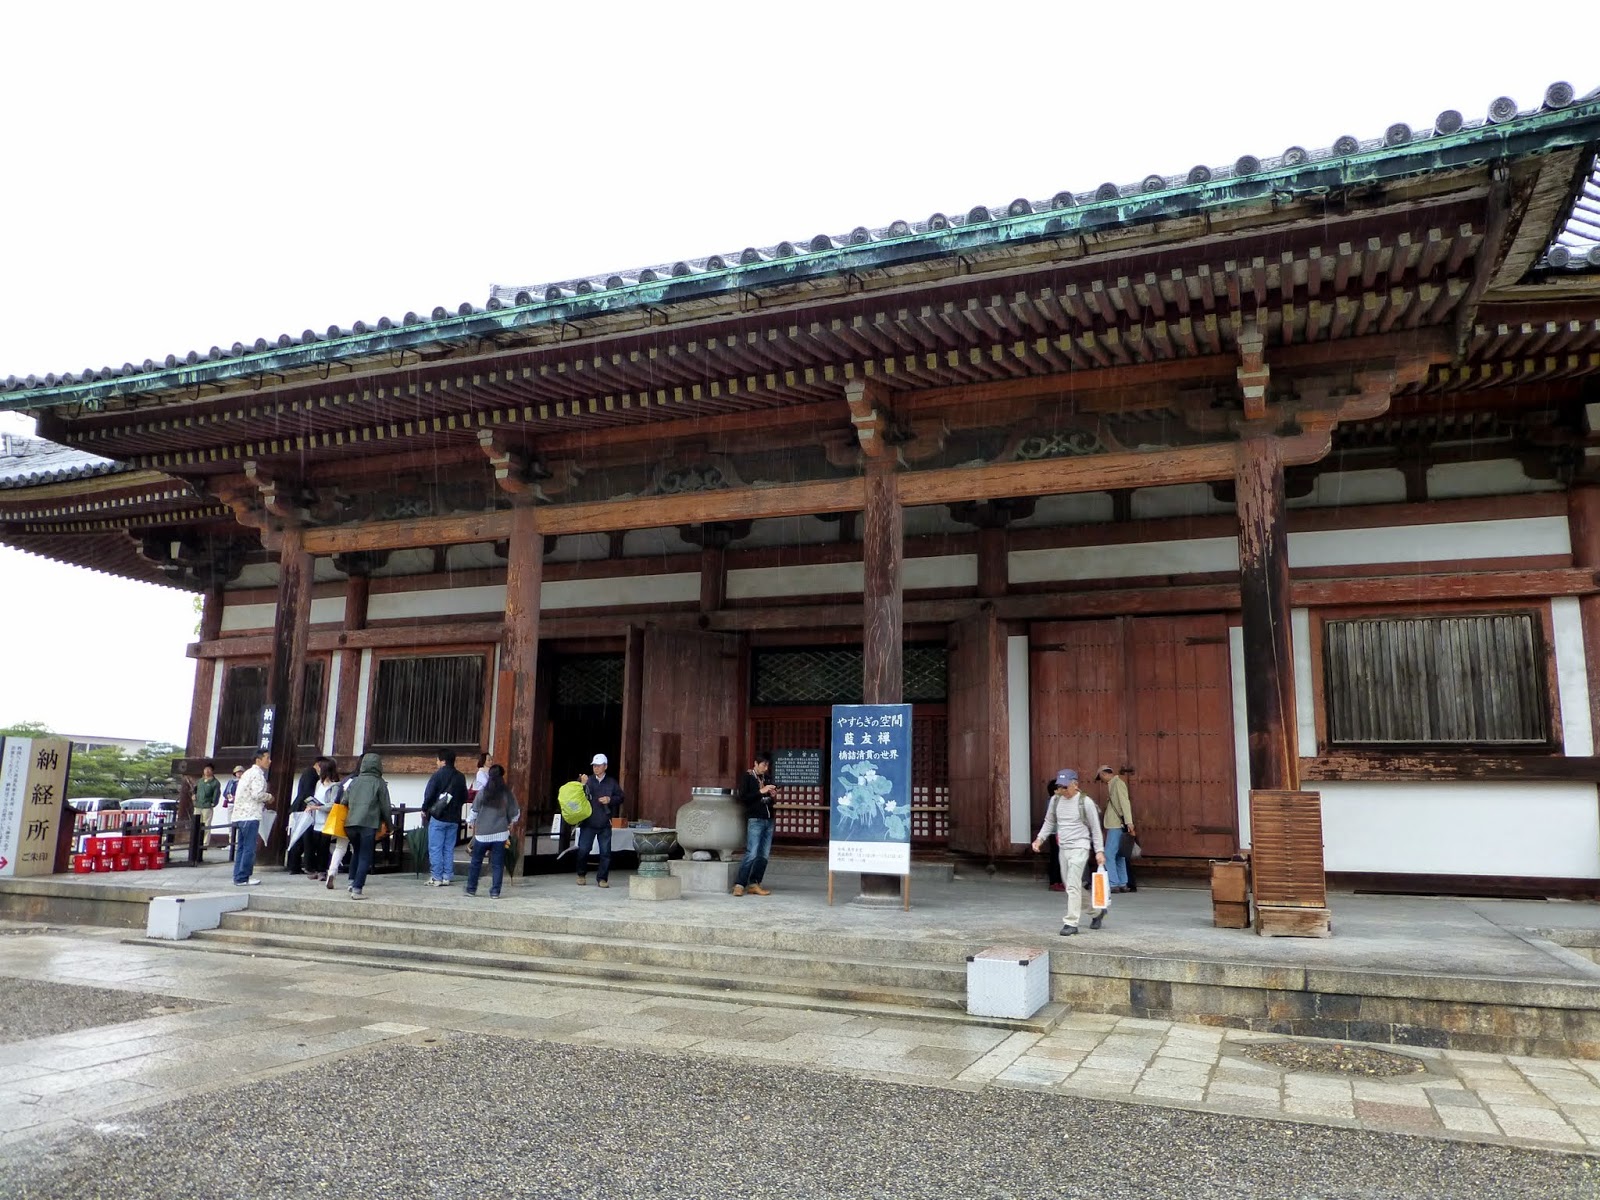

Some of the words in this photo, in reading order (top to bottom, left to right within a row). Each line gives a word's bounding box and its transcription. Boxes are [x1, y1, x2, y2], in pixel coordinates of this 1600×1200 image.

[261, 708, 273, 749] 納経所
[837, 714, 903, 728] やすらぎの空間
[26, 748, 59, 841] 納経所
[21, 852, 49, 862] ご朱印
